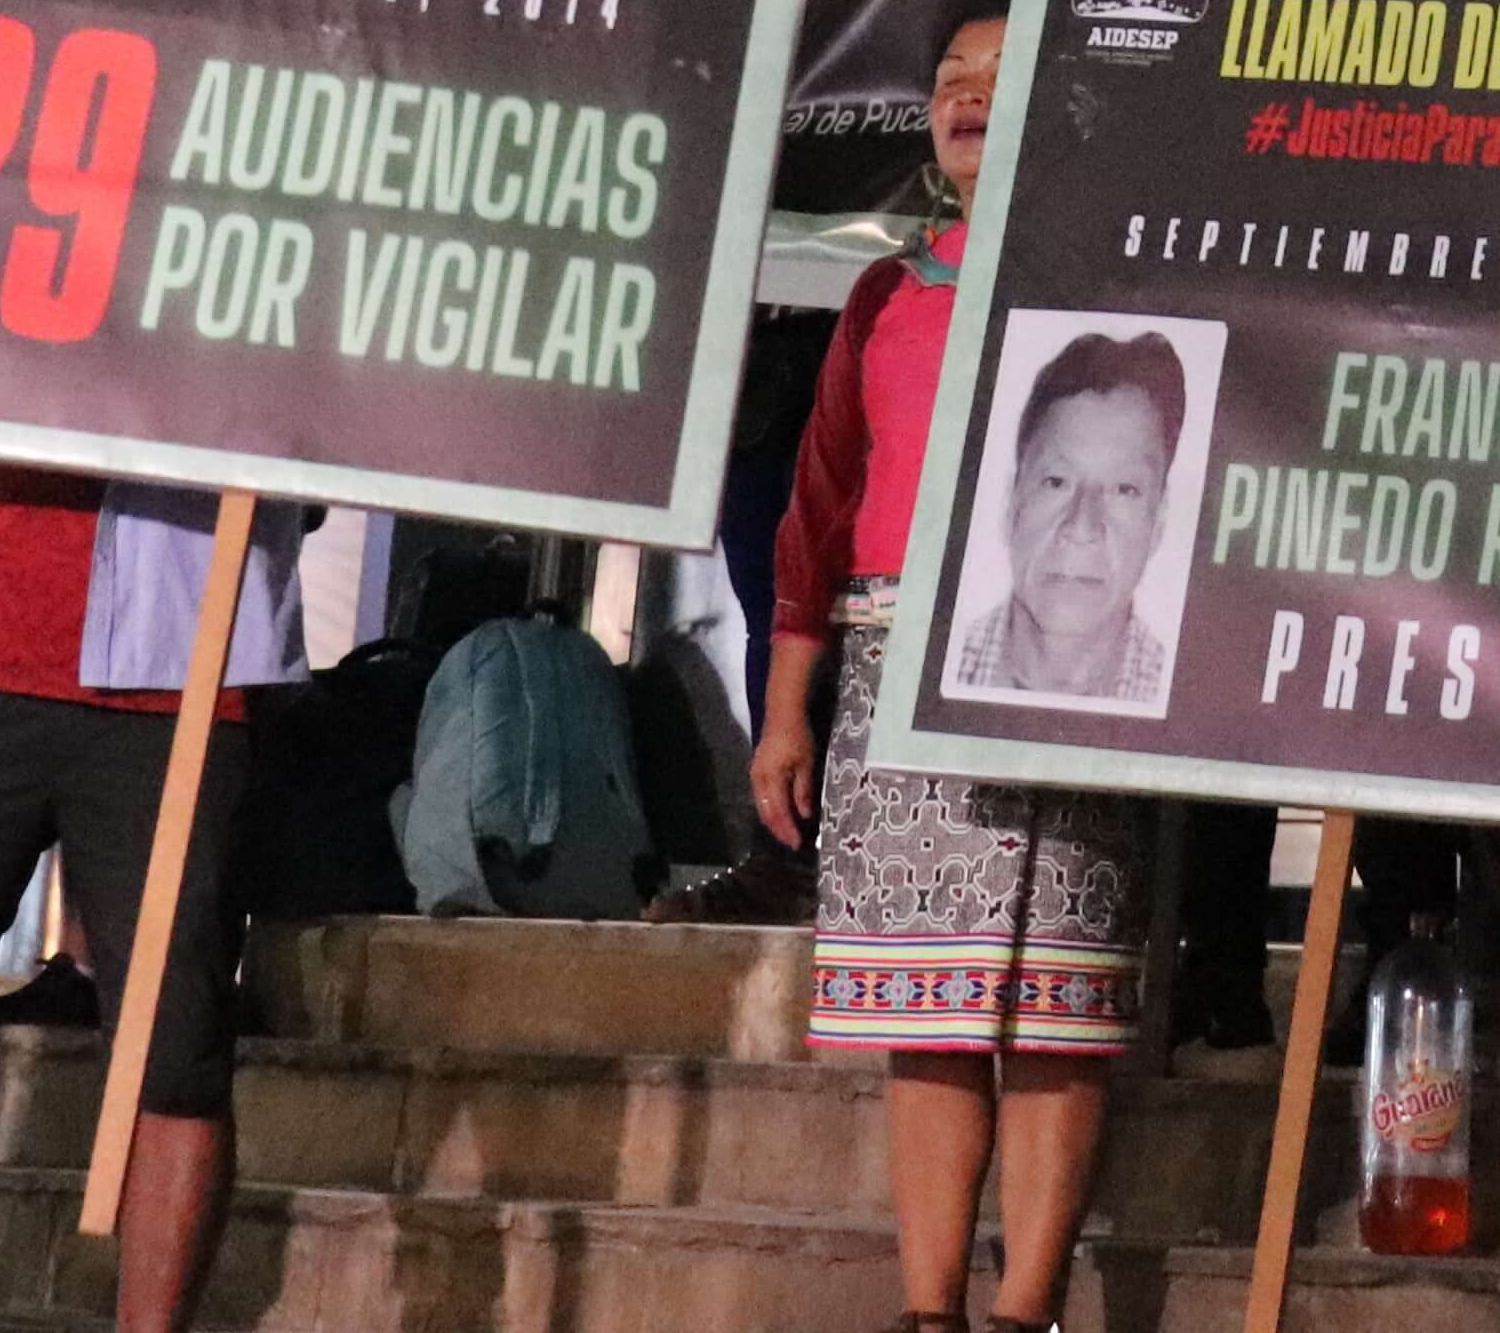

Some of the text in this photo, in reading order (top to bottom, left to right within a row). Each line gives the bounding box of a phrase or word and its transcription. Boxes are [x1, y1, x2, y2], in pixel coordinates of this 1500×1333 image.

[1087, 27, 1179, 50] AIDESEP
[170, 58, 668, 241] AUDIENCIAS
[816, 102, 855, 135] de
[860, 99, 933, 133] Puca
[139, 206, 658, 393] POR VIGILAR
[1213, 463, 1458, 582] PINEDO
